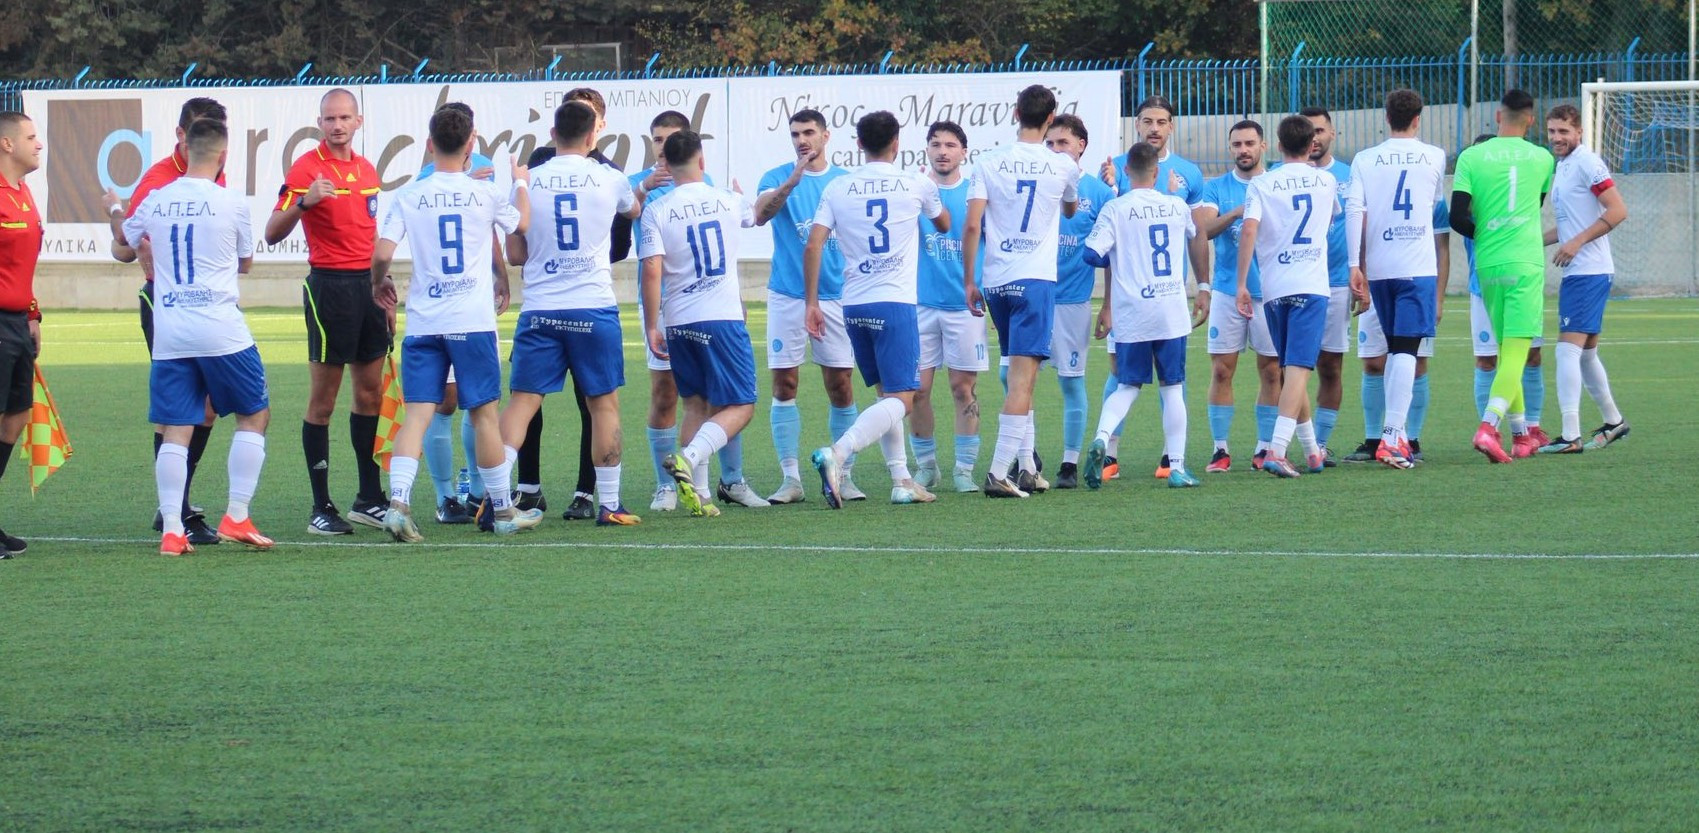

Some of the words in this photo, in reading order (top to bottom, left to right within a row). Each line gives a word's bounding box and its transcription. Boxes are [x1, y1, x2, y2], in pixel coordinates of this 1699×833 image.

[608, 88, 691, 109] ΜΠΑΝΙΟΥ
[998, 160, 1057, 176] Α.Π.Ε.Λ.
[1375, 152, 1431, 166] Α.Π.Ε.Λ.
[532, 174, 600, 191] Α.Π.Ε.Λ.
[847, 179, 909, 196] Α.Π.Ε.Λ.
[1272, 175, 1327, 192] Α.Π.Ε.Λ.
[1508, 165, 1518, 212] 1
[418, 192, 482, 209] Α.Π.Ε.Λ.
[1393, 169, 1413, 220] 4
[152, 201, 216, 217] Α.Π.Ε.Λ.
[669, 199, 730, 222] Α.Π.Ε.Λ.
[1016, 179, 1037, 232] 7
[554, 193, 580, 250] 6
[866, 198, 890, 254] 3
[1292, 193, 1312, 244] 2
[45, 239, 97, 253] ΥΛΙΚΑ
[170, 223, 194, 284] 11
[438, 214, 464, 275] 9
[687, 220, 726, 278] 10
[1149, 224, 1172, 277] 8
[540, 316, 594, 327] Typocenter
[975, 343, 985, 361] 10
[1069, 351, 1079, 367] 8
